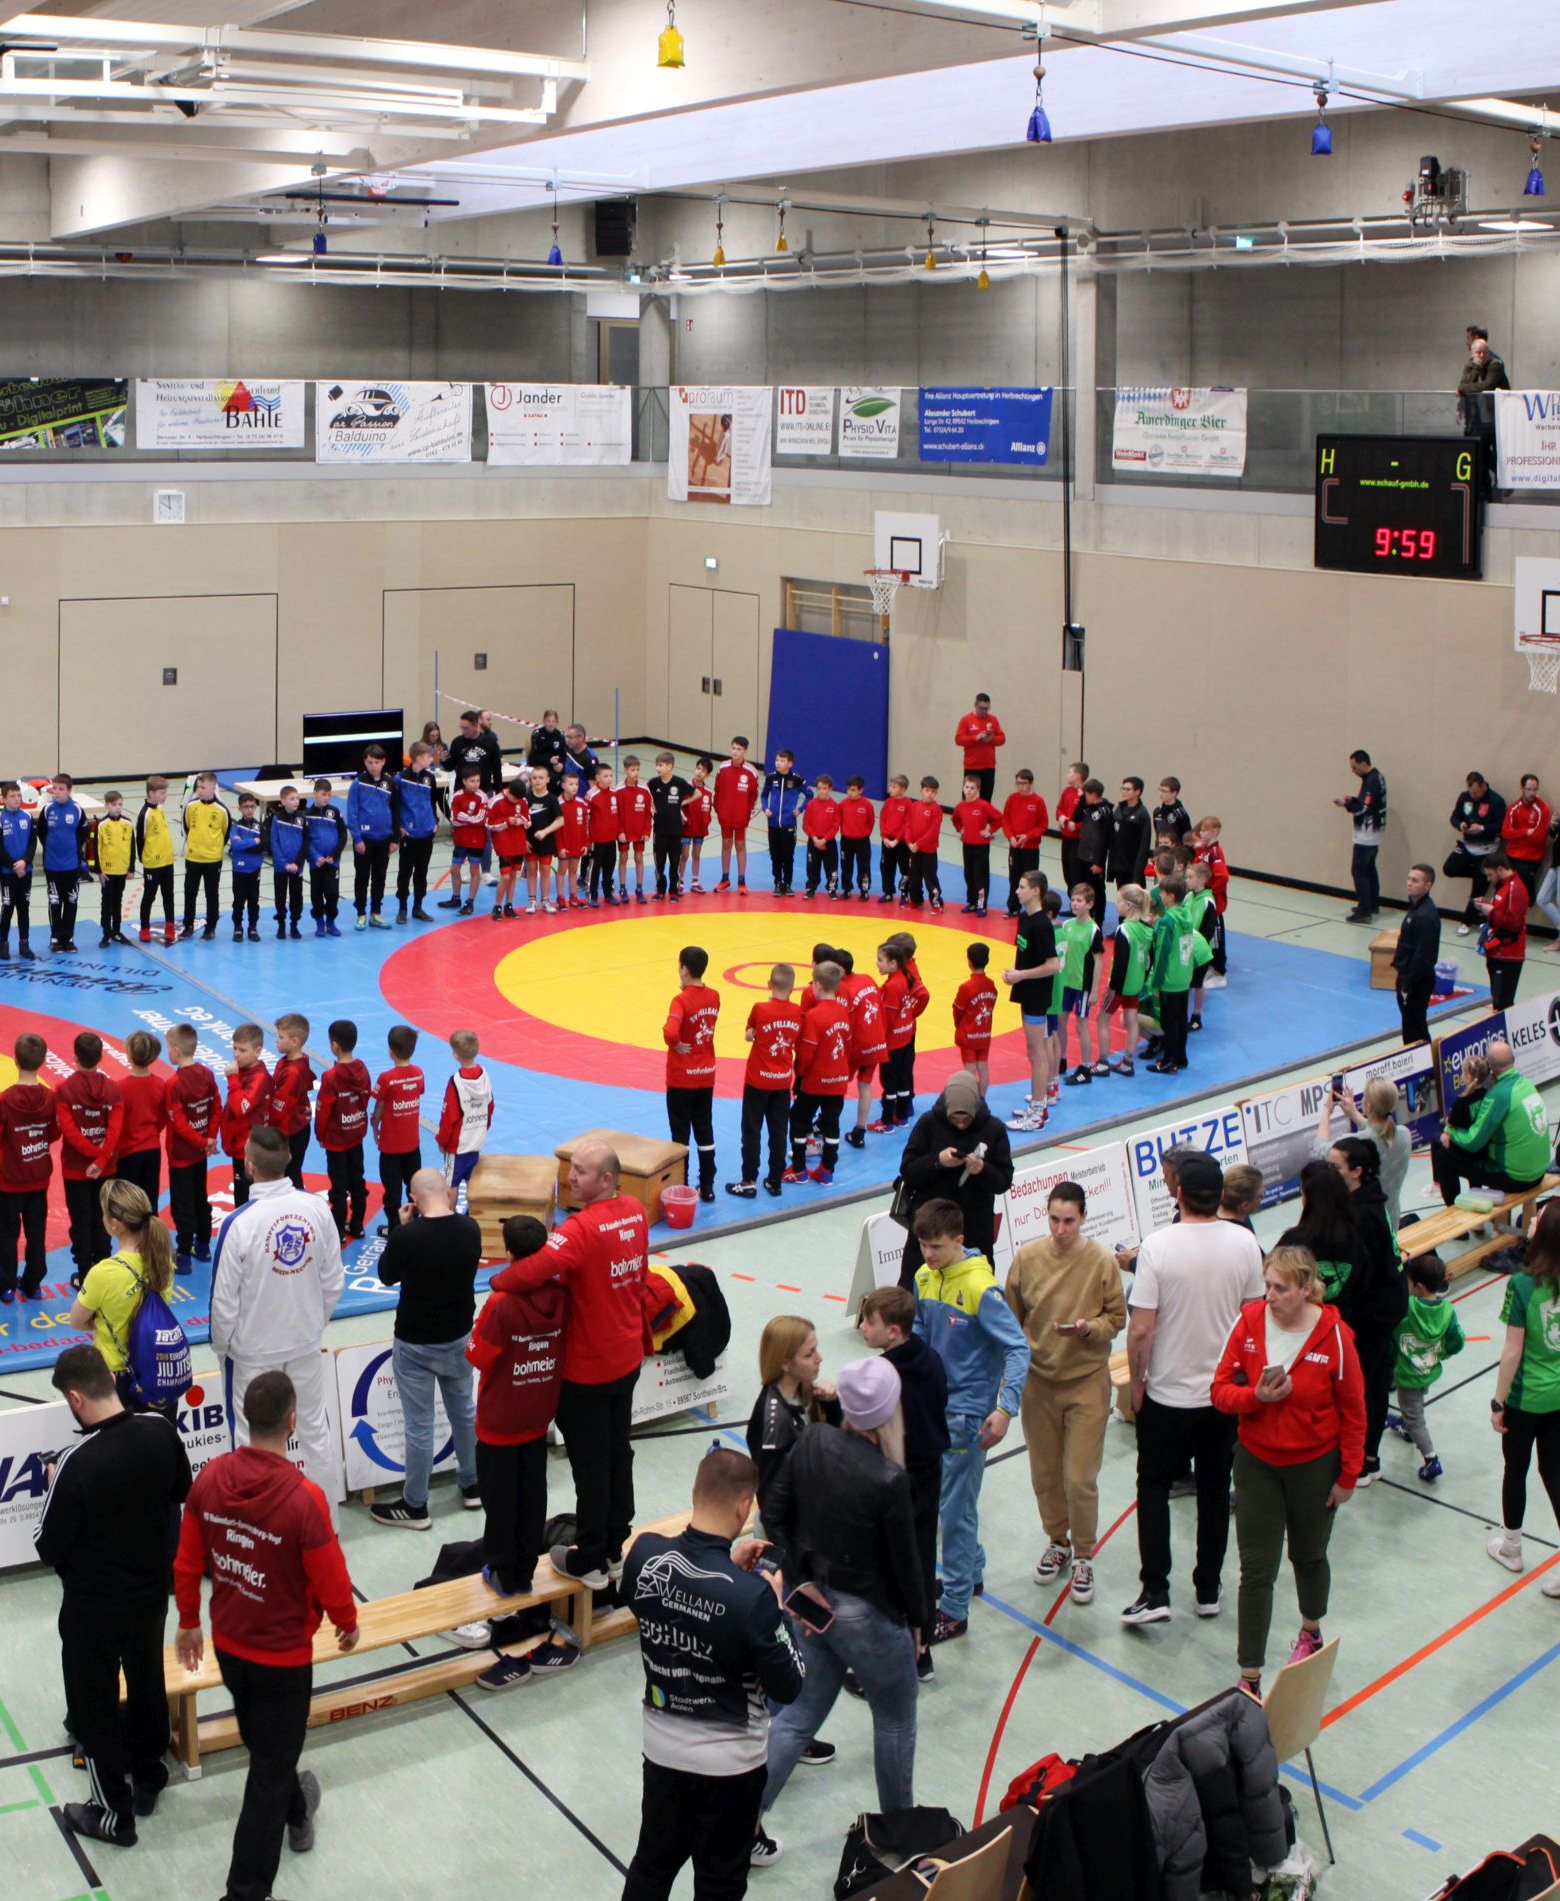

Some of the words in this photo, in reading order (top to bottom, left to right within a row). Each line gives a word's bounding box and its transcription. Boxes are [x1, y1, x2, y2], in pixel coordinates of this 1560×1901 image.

[516, 389, 562, 404] Jander
[689, 391, 733, 405] proraum
[779, 389, 805, 415] ITD
[335, 431, 387, 442] Balduino
[1011, 443, 1035, 453] Allianz
[1320, 448, 1335, 475] H
[1455, 452, 1471, 480] G
[1359, 478, 1429, 490] www.schauf-gmbh.de
[1375, 528, 1436, 559] 9:59
[1511, 1020, 1546, 1050] KELES
[1010, 1170, 1068, 1200] Bedachungen
[157, 1362, 173, 1378] JIU
[659, 1581, 727, 1616] WELLAND
[661, 1596, 711, 1622] GERMANEN
[329, 1695, 394, 1721] BENZ
